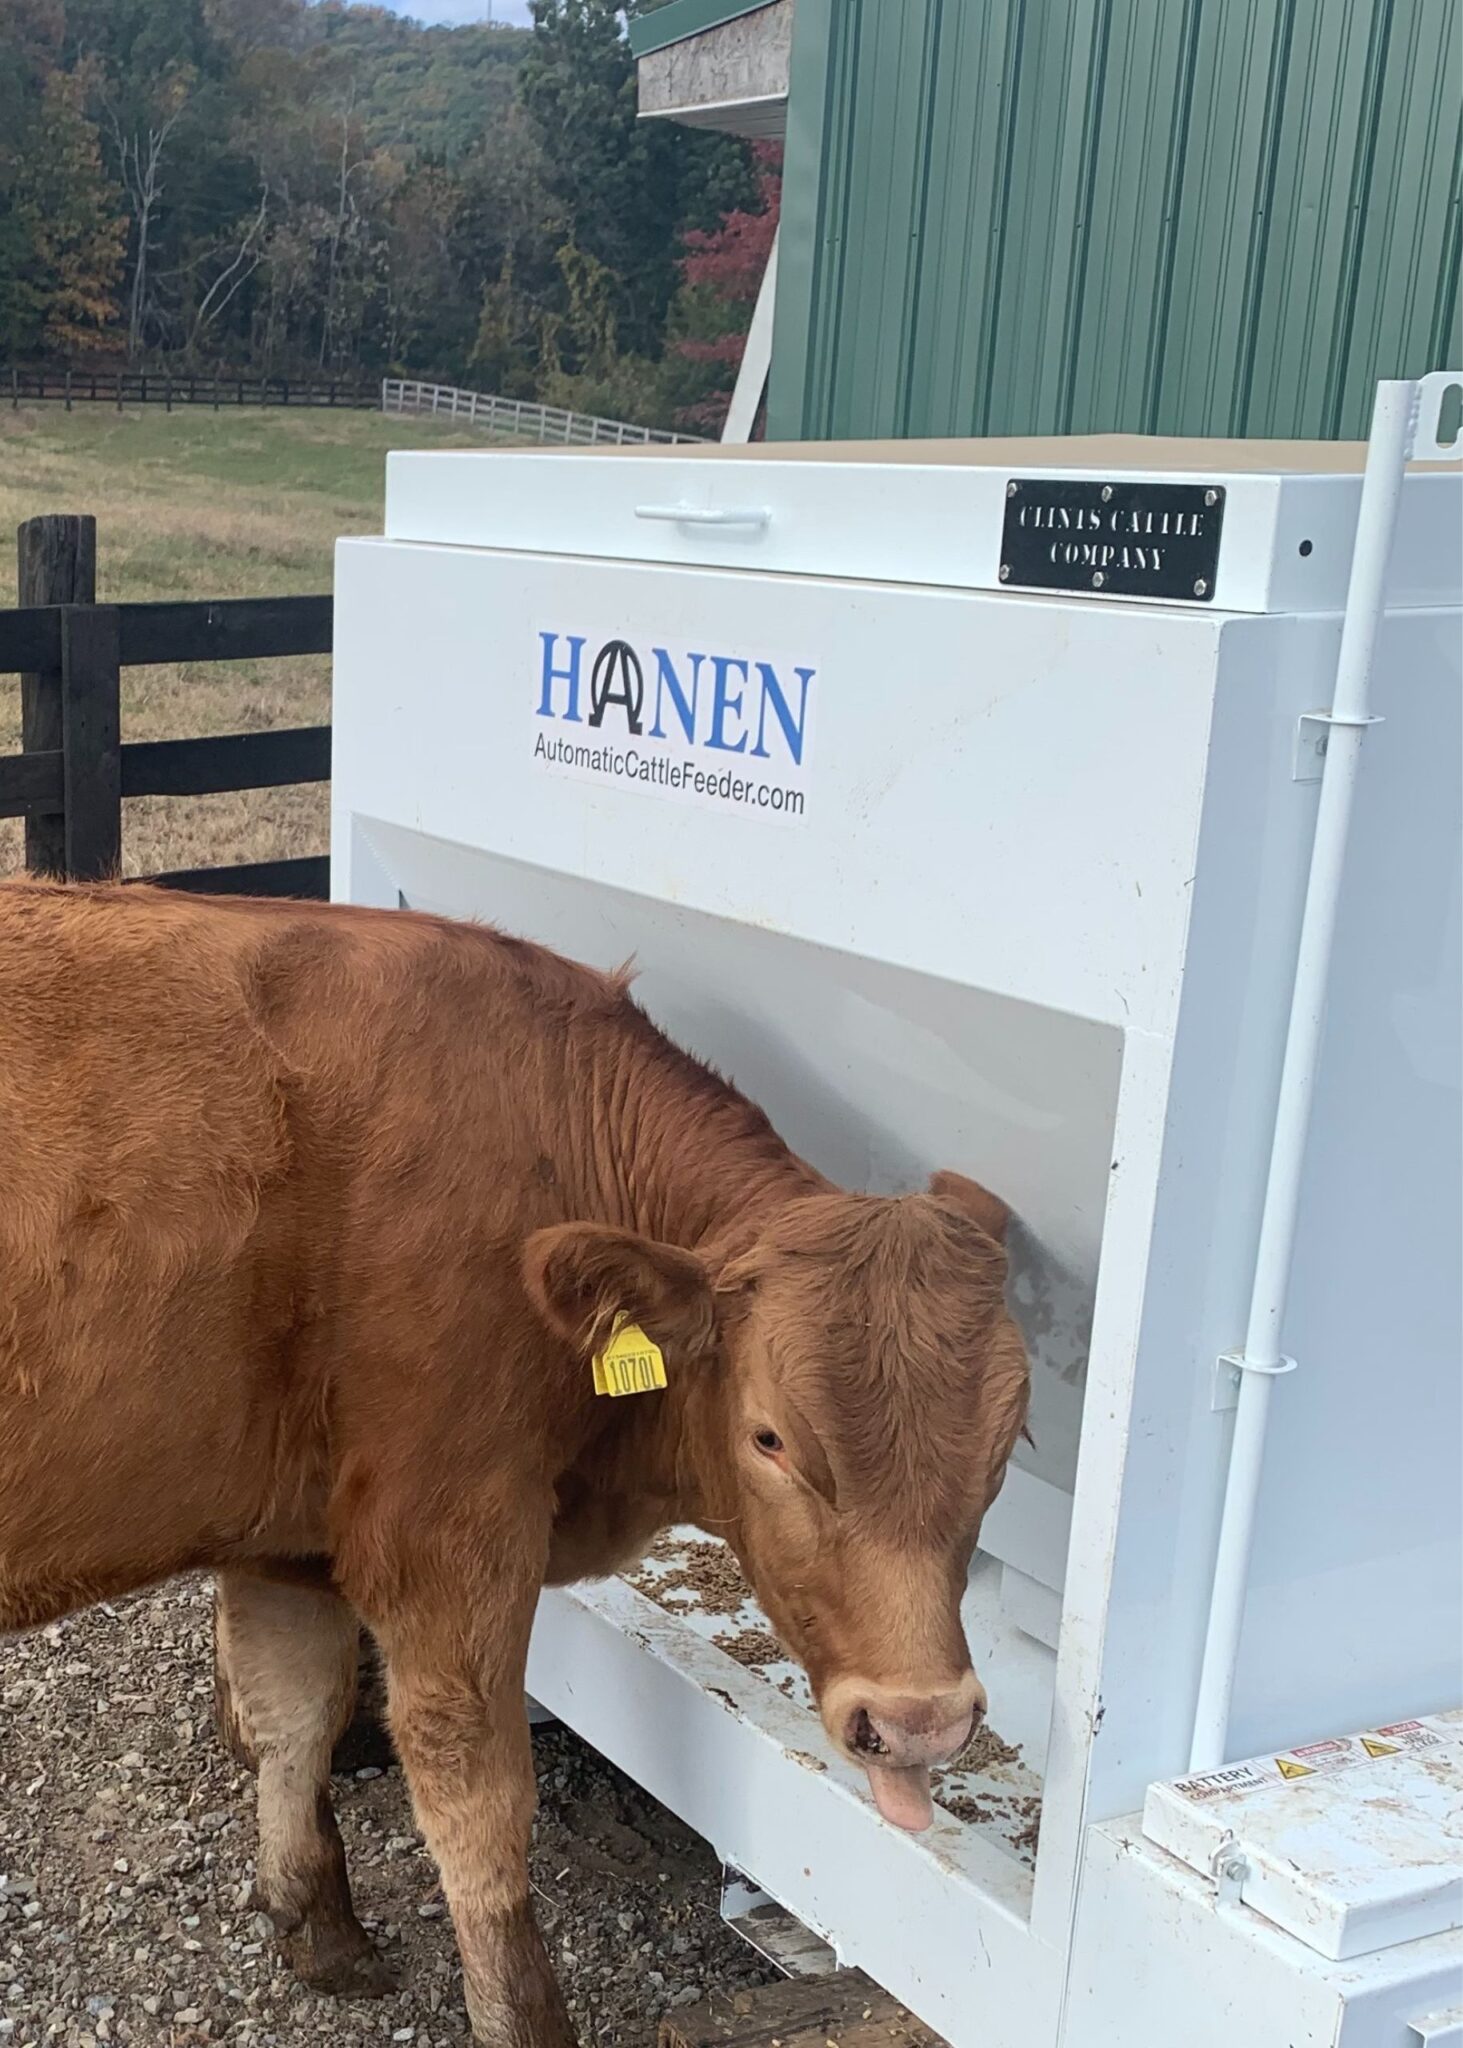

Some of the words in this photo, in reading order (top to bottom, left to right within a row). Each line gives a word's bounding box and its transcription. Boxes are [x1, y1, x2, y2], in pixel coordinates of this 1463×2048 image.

[1050, 541, 1166, 571] COMPANY
[536, 631, 817, 766] HANEN
[534, 732, 805, 815] AutomaticCattleFeeder.com
[1174, 1766, 1254, 1793] BATTERY
[1190, 1776, 1269, 1801] COMPARTMENT
